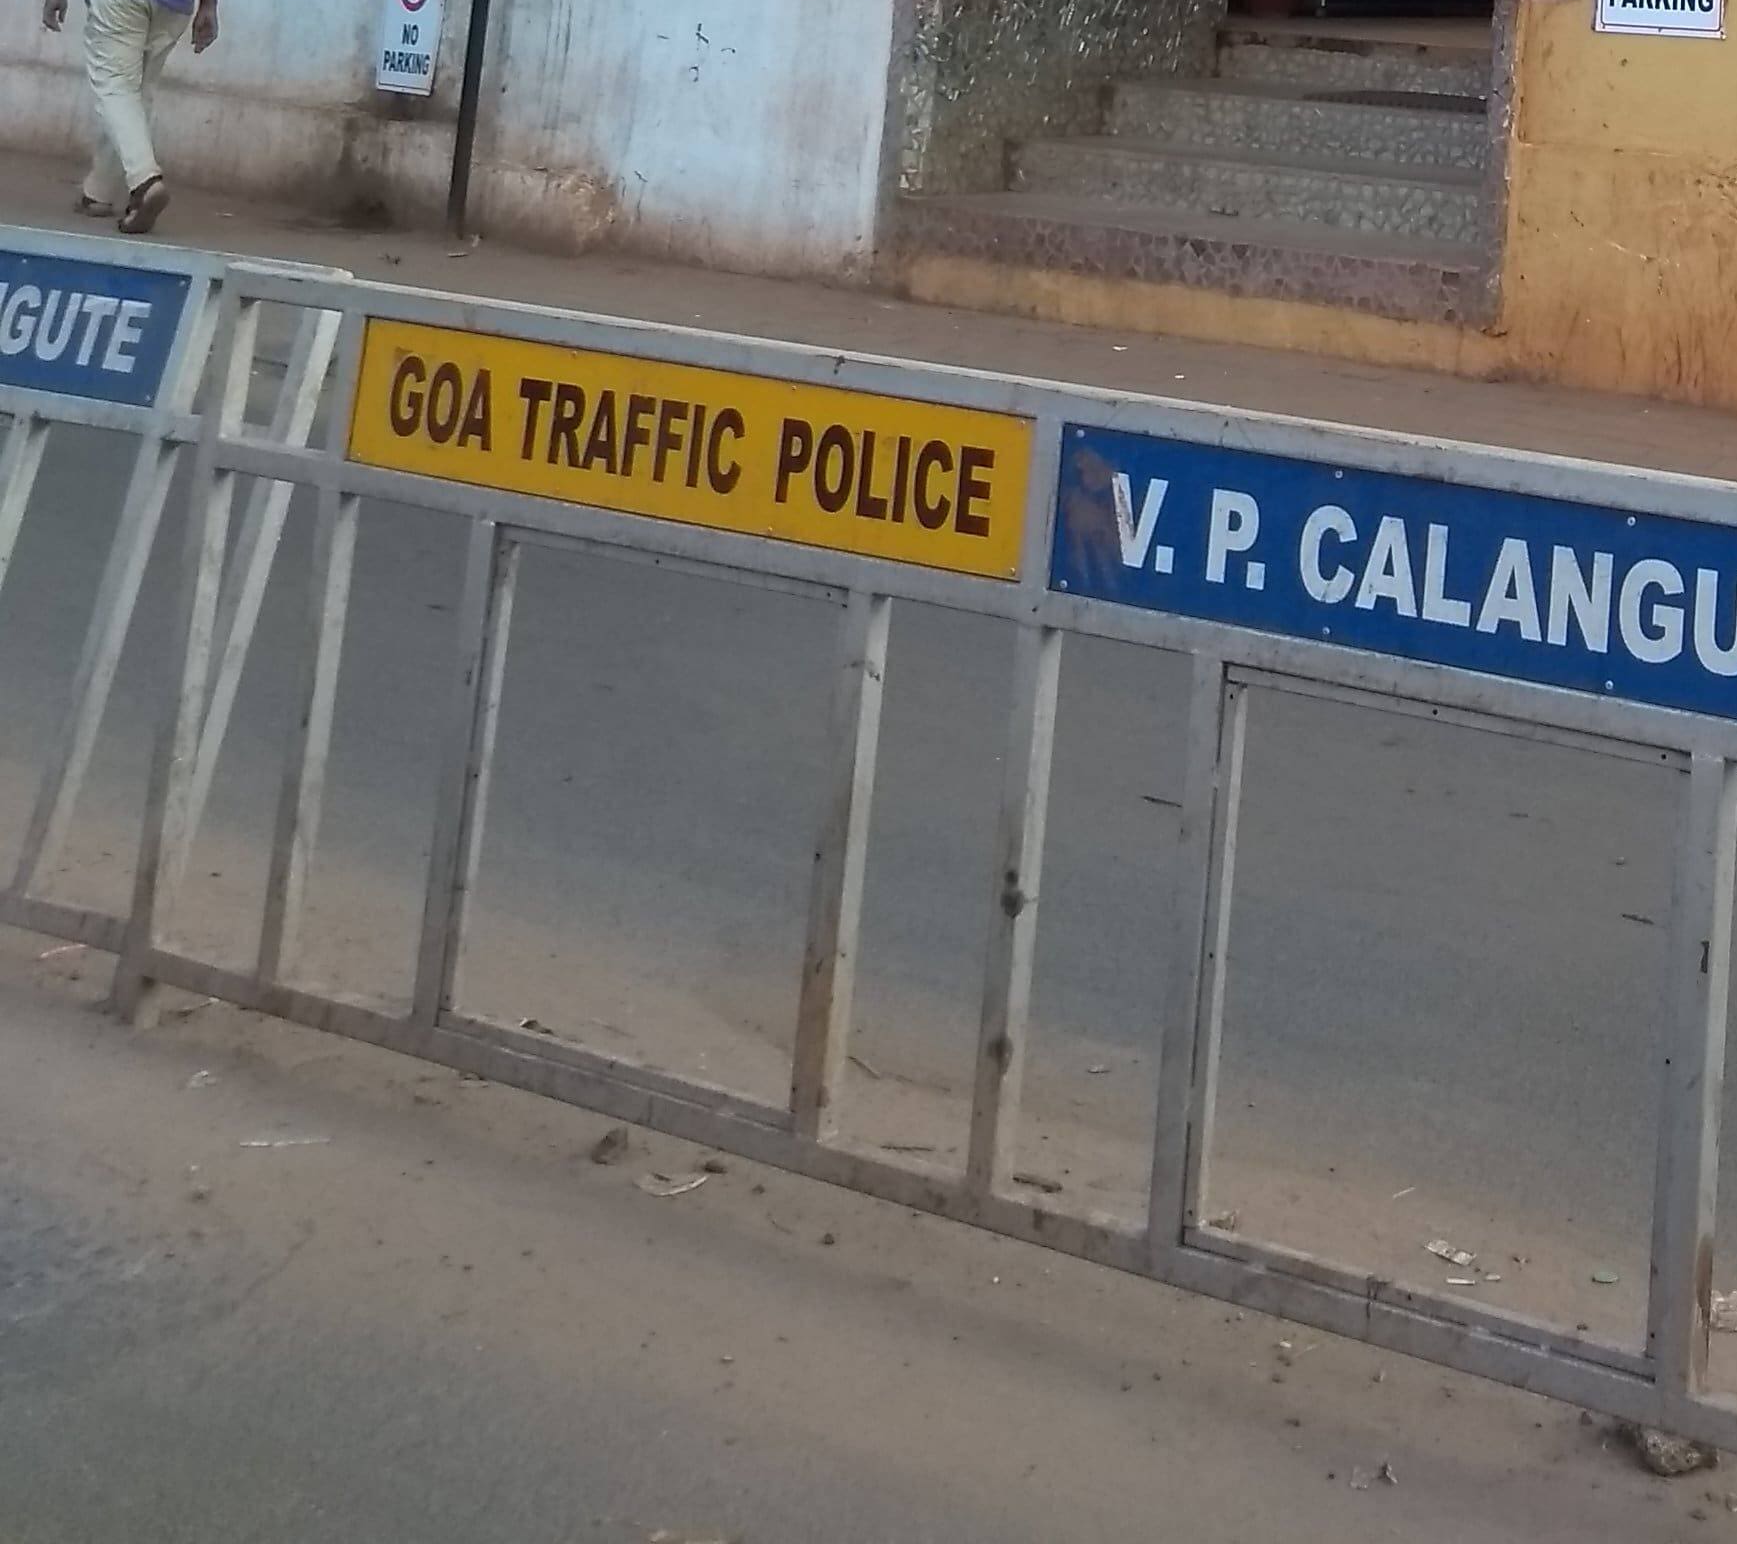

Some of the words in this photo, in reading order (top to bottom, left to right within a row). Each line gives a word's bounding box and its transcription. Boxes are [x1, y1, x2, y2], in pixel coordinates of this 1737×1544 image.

[382, 49, 431, 76] PARKING
[402, 23, 419, 46] NO
[0, 281, 152, 374] GUTE
[388, 353, 493, 452] GOA
[519, 376, 746, 495] TRAFFIC
[774, 416, 996, 538] POLICE
[1110, 470, 1174, 575] V.
[1204, 487, 1266, 590] P.
